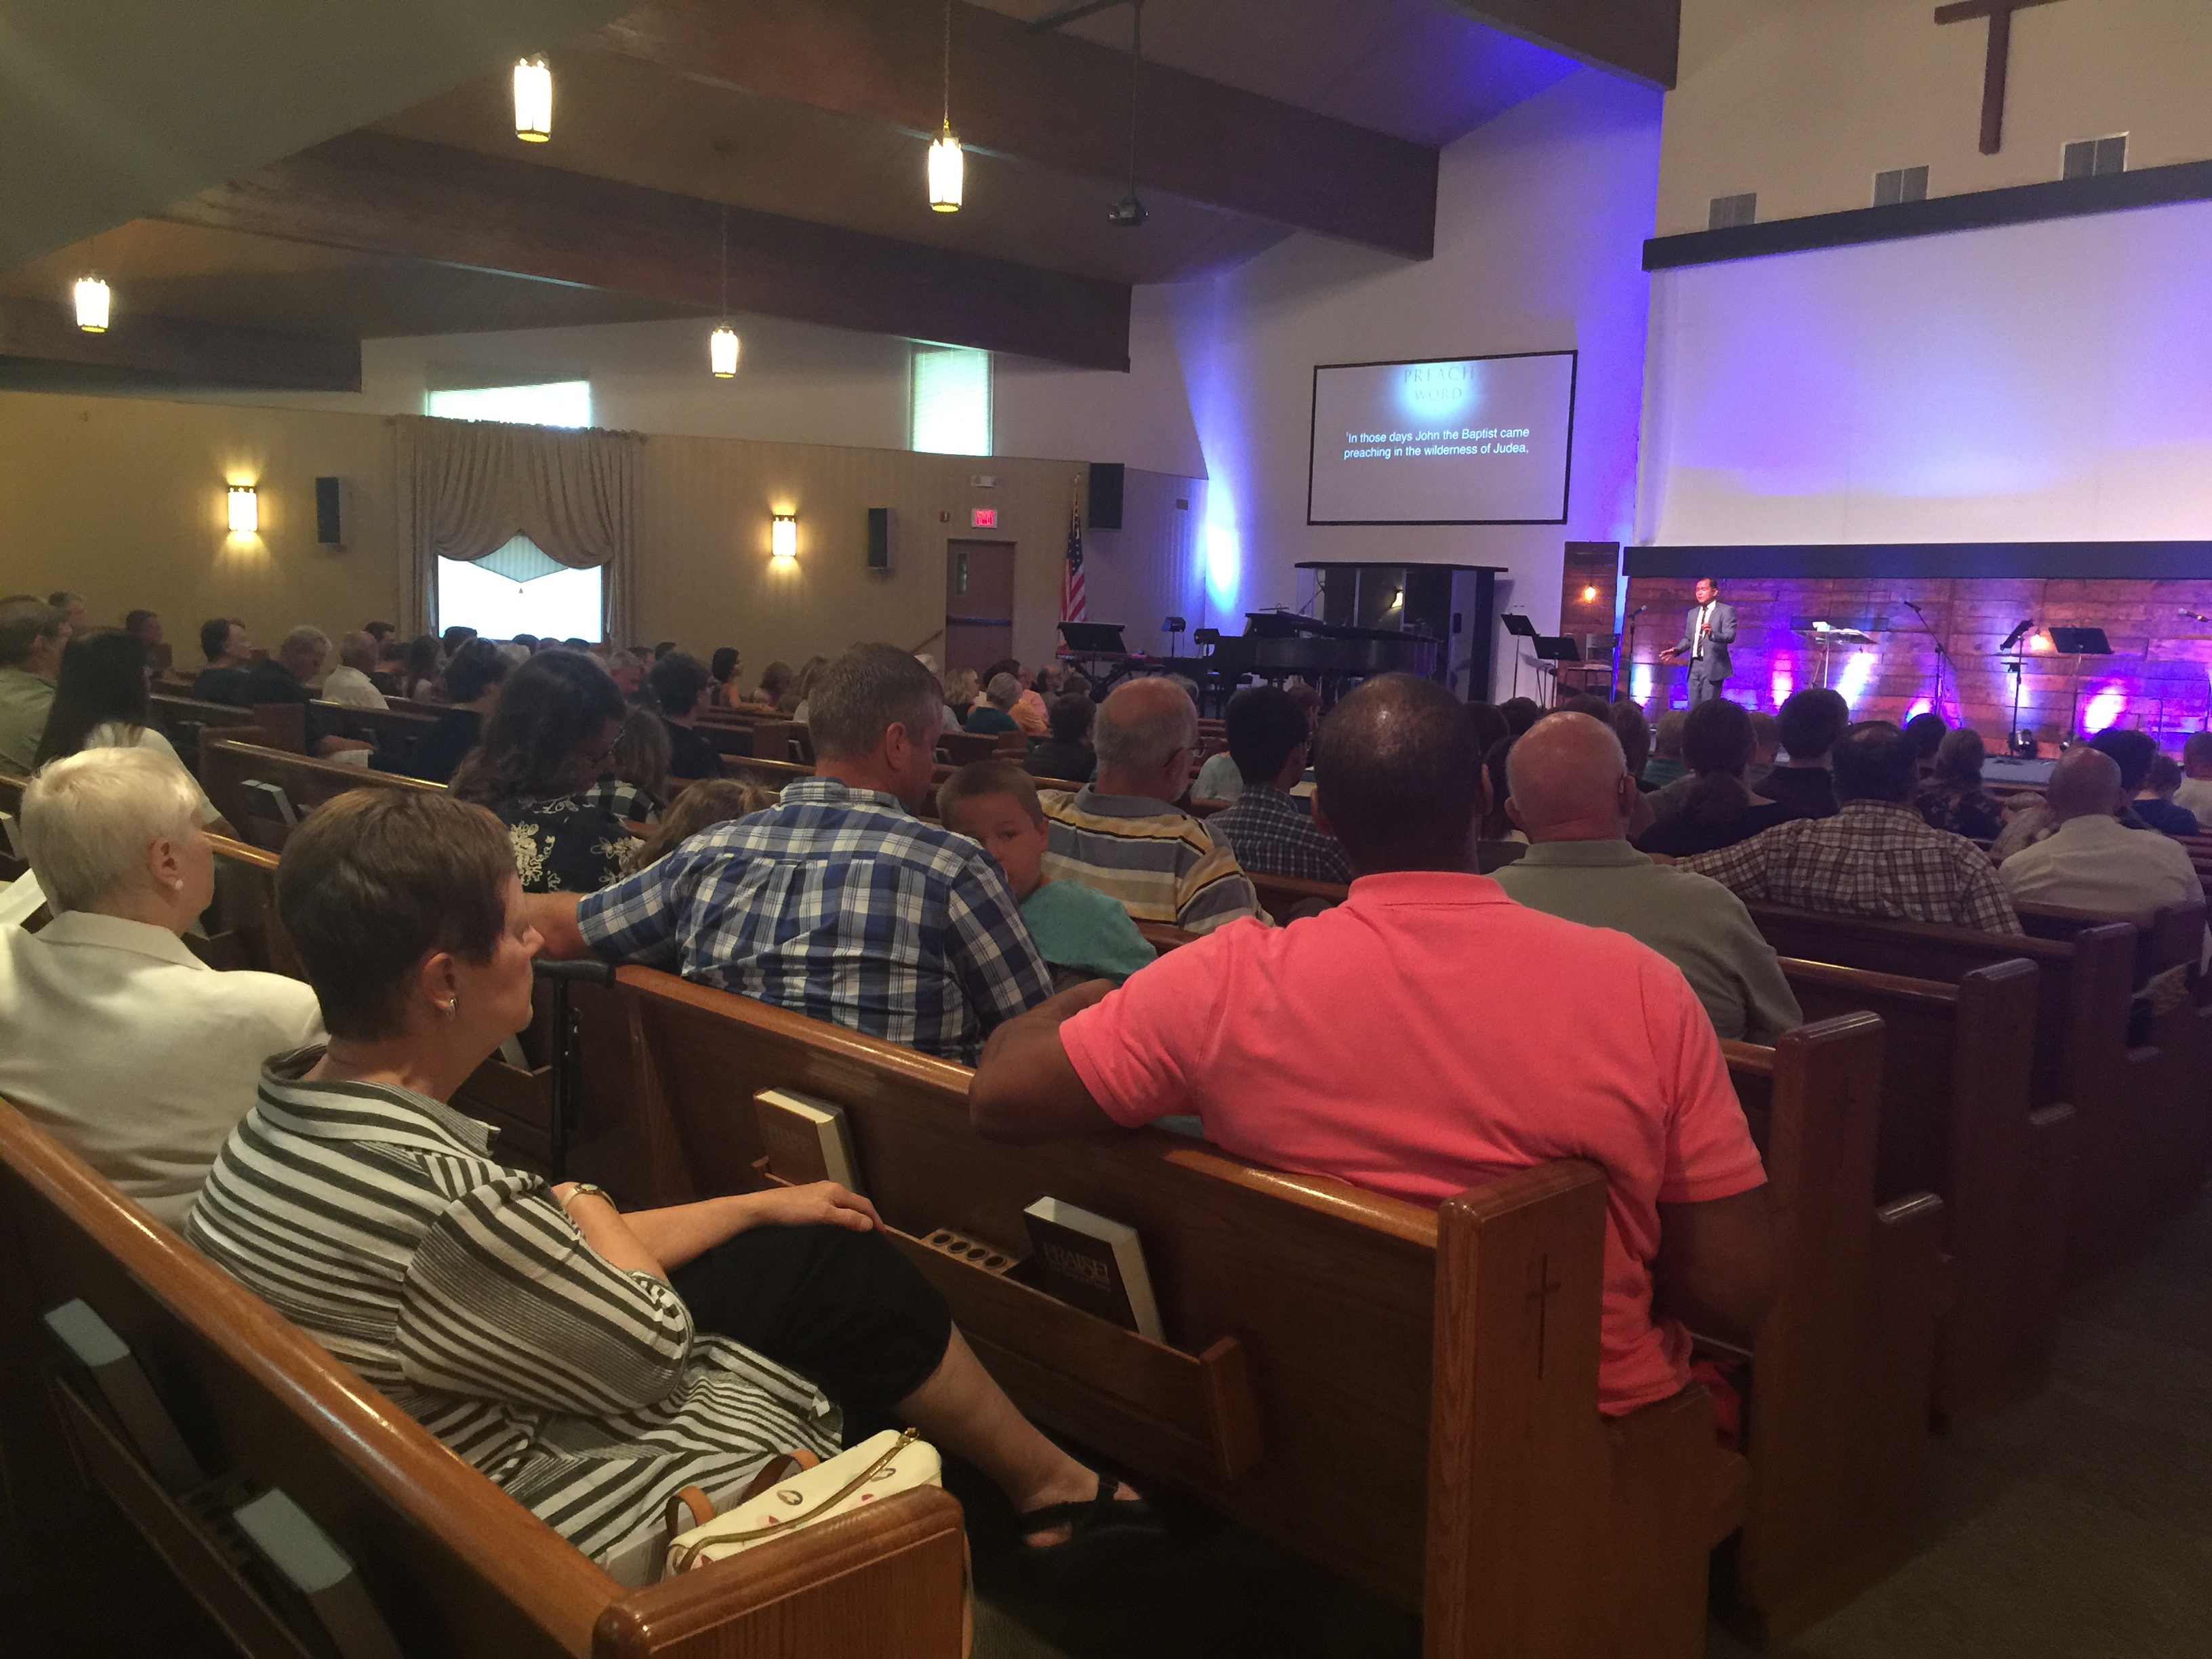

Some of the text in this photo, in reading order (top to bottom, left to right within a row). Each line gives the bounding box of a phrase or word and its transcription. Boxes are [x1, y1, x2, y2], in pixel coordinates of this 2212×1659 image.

[1404, 367, 1475, 383] PREACH
[1415, 387, 1462, 401] WORD
[1360, 432, 1387, 443] those
[1389, 432, 1413, 445] days
[1415, 430, 1440, 441] John
[1443, 430, 1459, 440] the
[1461, 428, 1498, 441] Baptist
[1500, 428, 1530, 438] came
[1343, 447, 1391, 460] preaching
[1394, 446, 1403, 456] in
[1406, 445, 1422, 456] the
[1424, 445, 1478, 455] wilderness
[1480, 443, 1491, 454] of
